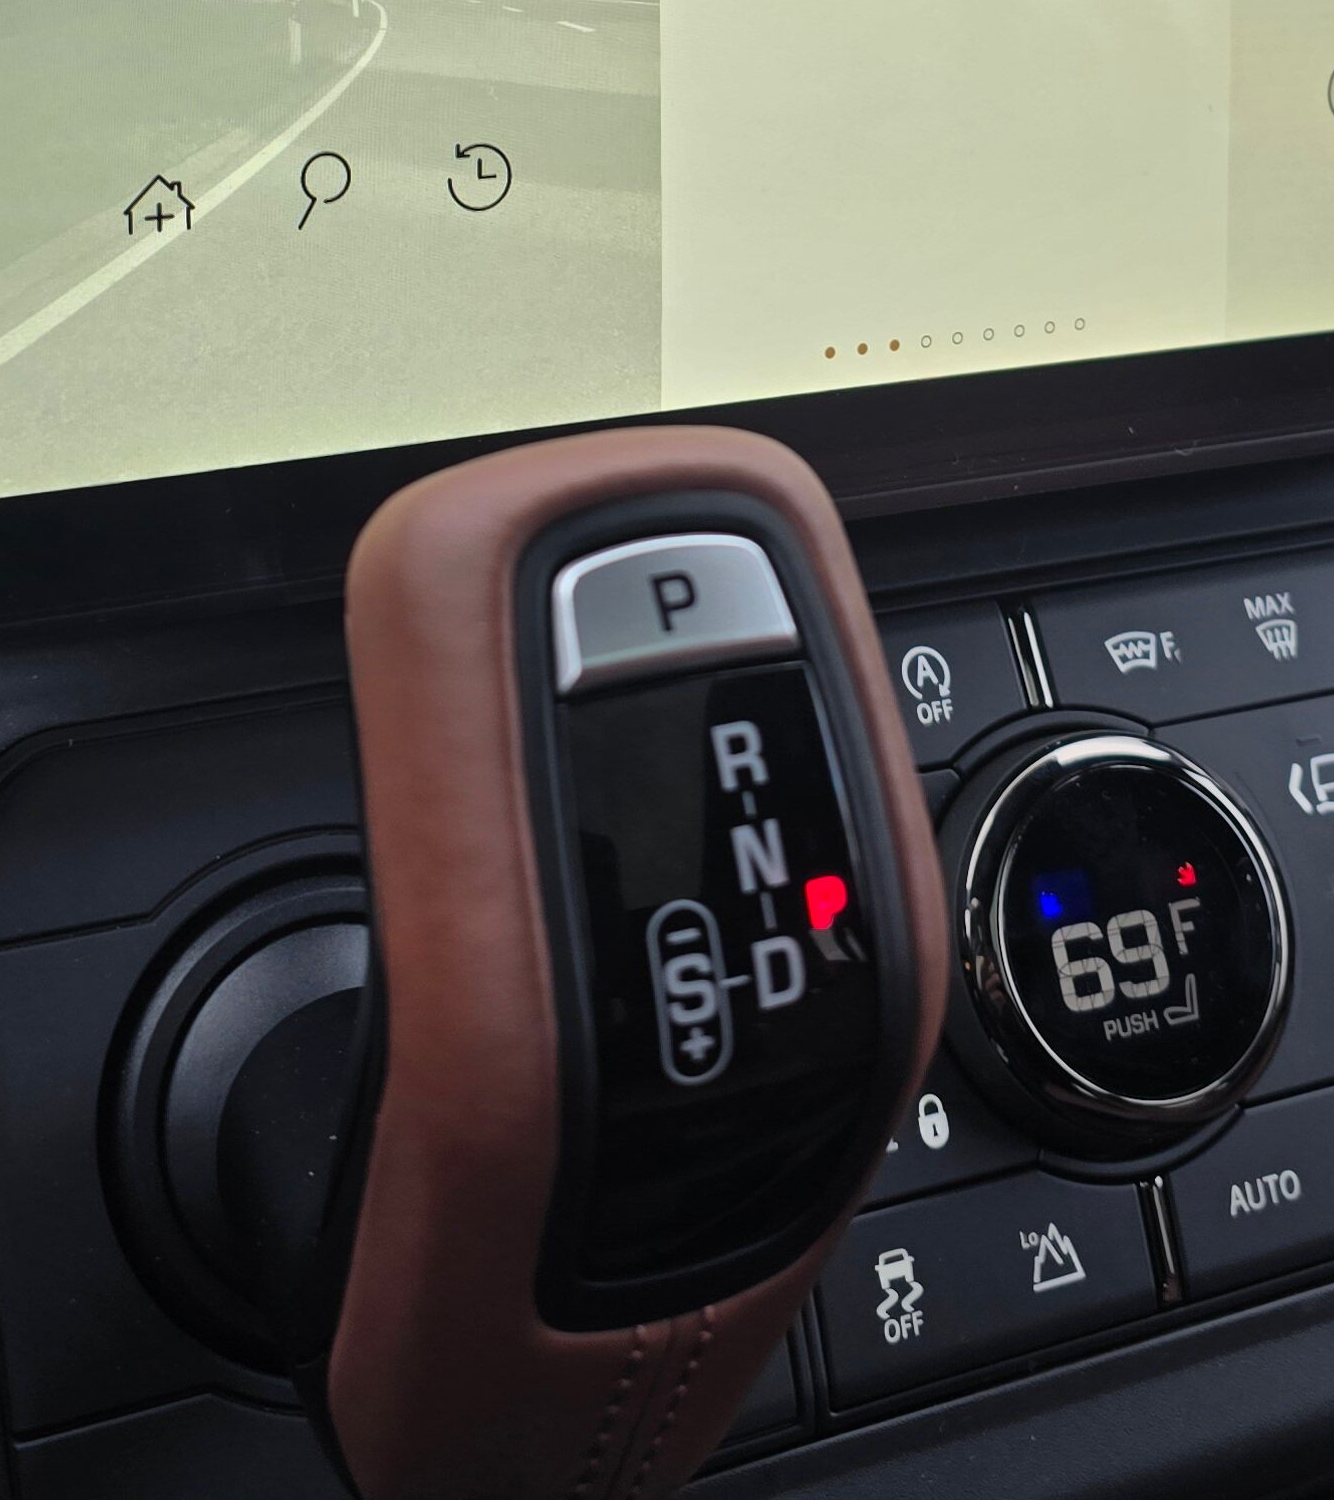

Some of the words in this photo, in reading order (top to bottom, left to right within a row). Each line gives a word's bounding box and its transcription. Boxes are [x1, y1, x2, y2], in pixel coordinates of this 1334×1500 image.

[649, 569, 698, 632] P
[1243, 592, 1294, 620] MAX
[916, 698, 954, 727] OFF
[711, 720, 768, 793] R
[730, 819, 789, 893] N
[665, 952, 717, 1025] S
[752, 934, 806, 1011] D
[1051, 909, 1170, 1012] 69
[1103, 1011, 1159, 1042] PUSH
[1228, 1169, 1303, 1217] AUTO
[883, 1310, 924, 1344] OFF
